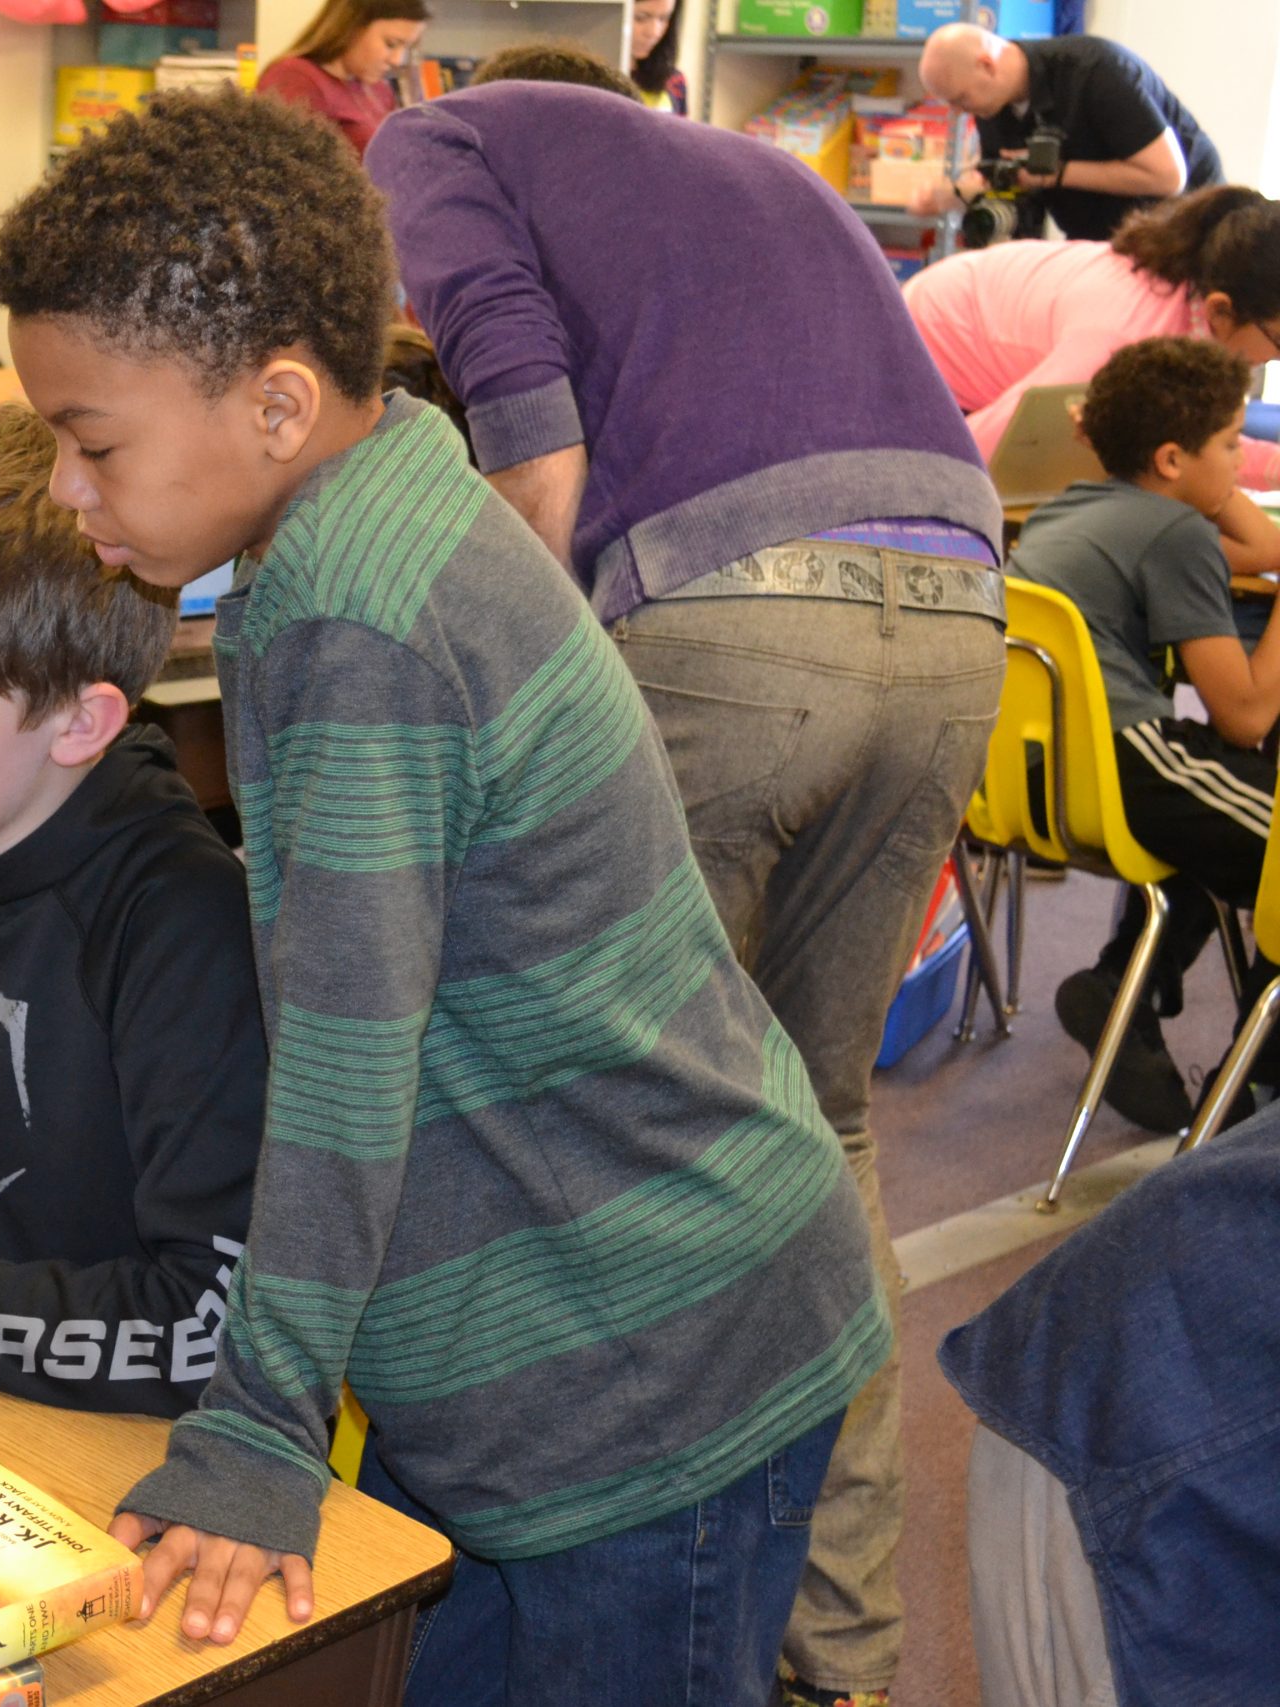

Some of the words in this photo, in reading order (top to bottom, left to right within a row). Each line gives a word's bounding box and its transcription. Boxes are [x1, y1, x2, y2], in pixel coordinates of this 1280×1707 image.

[0, 1481, 26, 1496] JACK
[5, 1501, 53, 1532] TIFFANY
[15, 1525, 57, 1549] J.K.
[54, 1531, 92, 1553] JOHN
[26, 1604, 37, 1628] ONE
[39, 1600, 49, 1628] TWO
[40, 1630, 50, 1650] AND
